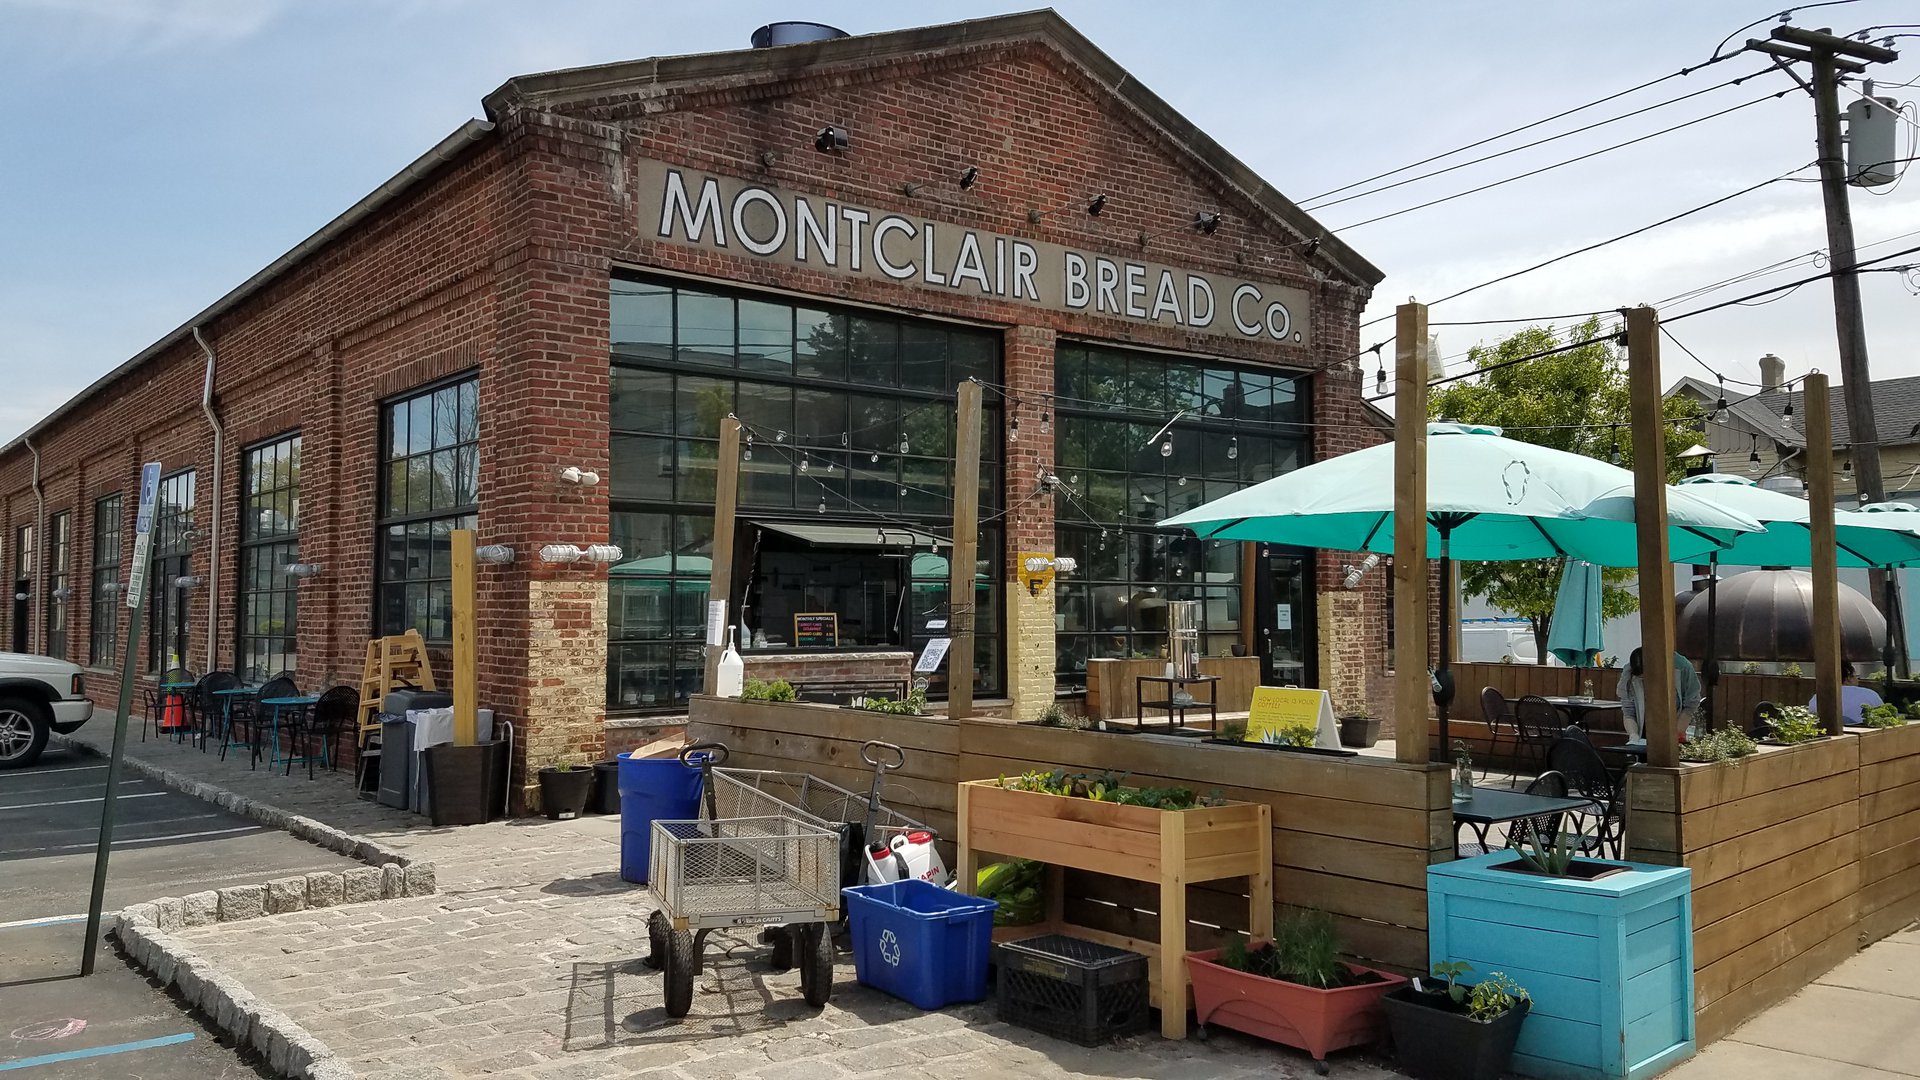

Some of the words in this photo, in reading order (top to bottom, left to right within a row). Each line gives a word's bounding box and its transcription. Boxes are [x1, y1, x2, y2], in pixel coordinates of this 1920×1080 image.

[658, 169, 1039, 301] MONTCLAIR
[1064, 251, 1215, 328] BREAD
[1231, 284, 1302, 342] Co.
[1272, 696, 1289, 704] LOCAL
[917, 866, 940, 880] APIN
